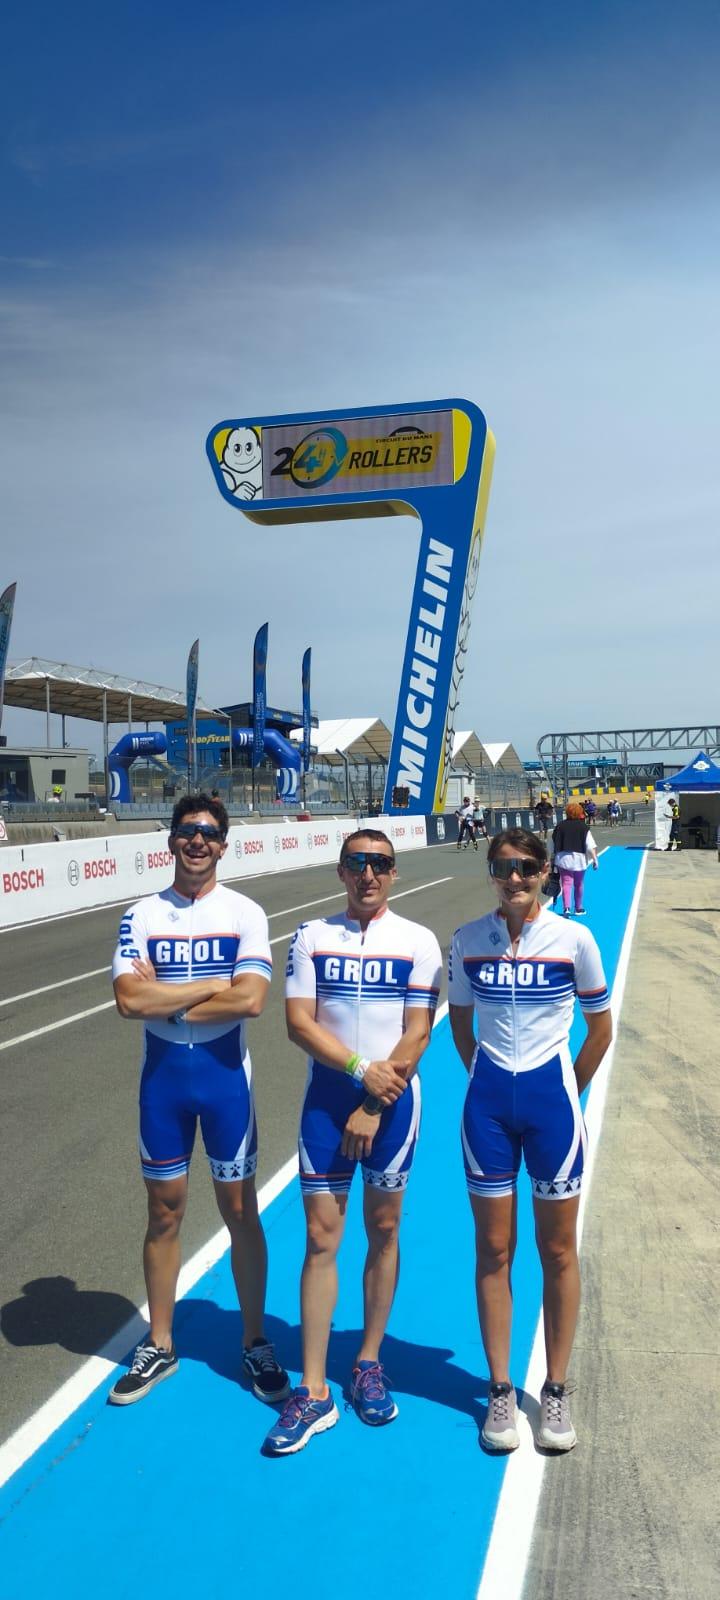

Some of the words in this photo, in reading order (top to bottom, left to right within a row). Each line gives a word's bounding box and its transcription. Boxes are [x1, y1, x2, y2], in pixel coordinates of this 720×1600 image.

[348, 445, 433, 470] ROLLERS
[396, 537, 454, 800] MICHELIN
[244, 840, 264, 854] BOSCH
[281, 836, 299, 850] BOSCH
[314, 834, 329, 846] BOSCH
[84, 858, 117, 880] BOSCH
[147, 850, 174, 869] BOSCH
[2, 868, 45, 893] BOSCH
[156, 939, 225, 963] GROL
[324, 957, 398, 984] GROL
[478, 962, 550, 986] GROL
